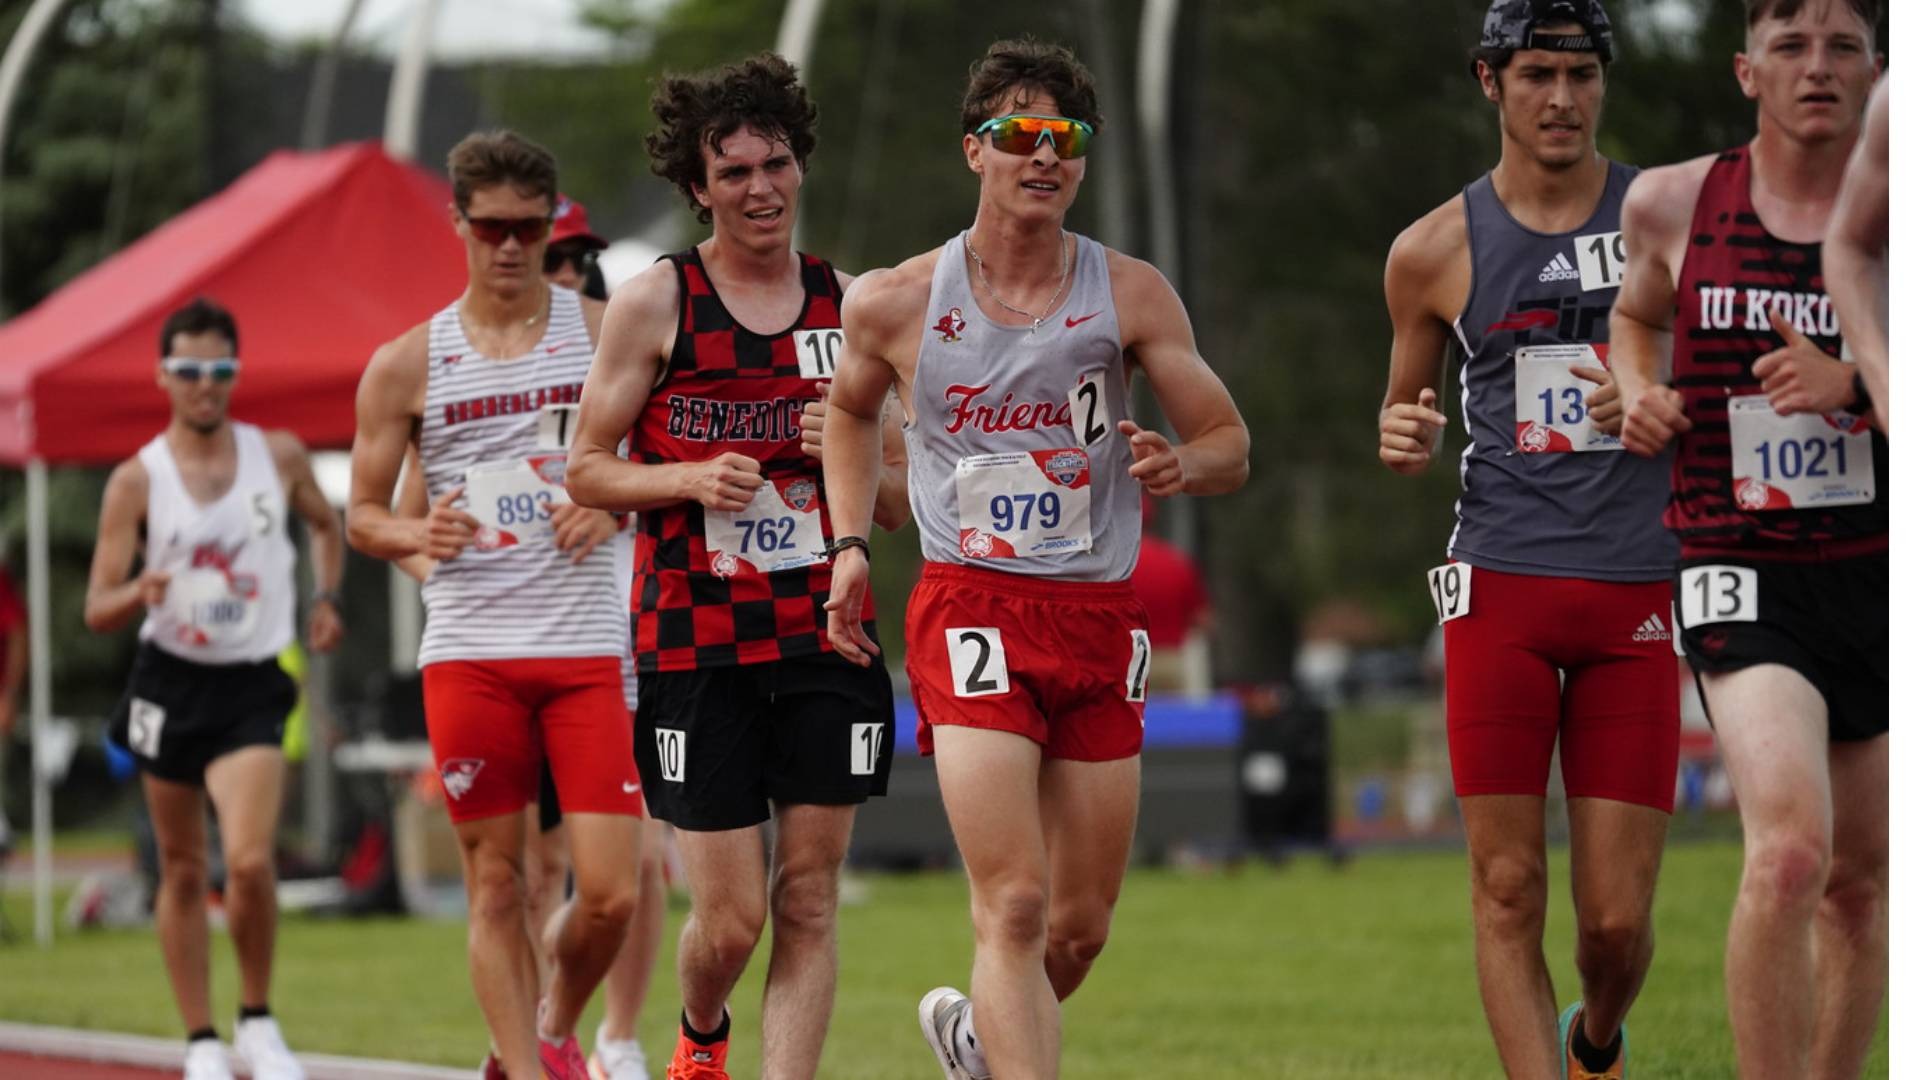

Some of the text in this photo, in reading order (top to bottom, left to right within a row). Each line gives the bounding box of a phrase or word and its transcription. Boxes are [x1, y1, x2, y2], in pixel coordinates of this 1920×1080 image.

[1538, 268, 1580, 283] adidas
[1700, 286, 1736, 330] IU
[804, 331, 843, 375] 10
[668, 395, 824, 442] BENEDIC
[1077, 381, 1106, 447] 2
[1537, 387, 1591, 425] 13
[1755, 436, 1847, 481] 1021
[253, 493, 273, 536] 5
[497, 490, 553, 526] 893
[989, 492, 1061, 532] 979
[735, 516, 797, 553] 762
[1432, 566, 1461, 620] 19
[1693, 571, 1742, 619] 13
[959, 631, 998, 694] 2
[658, 732, 679, 778] 10
